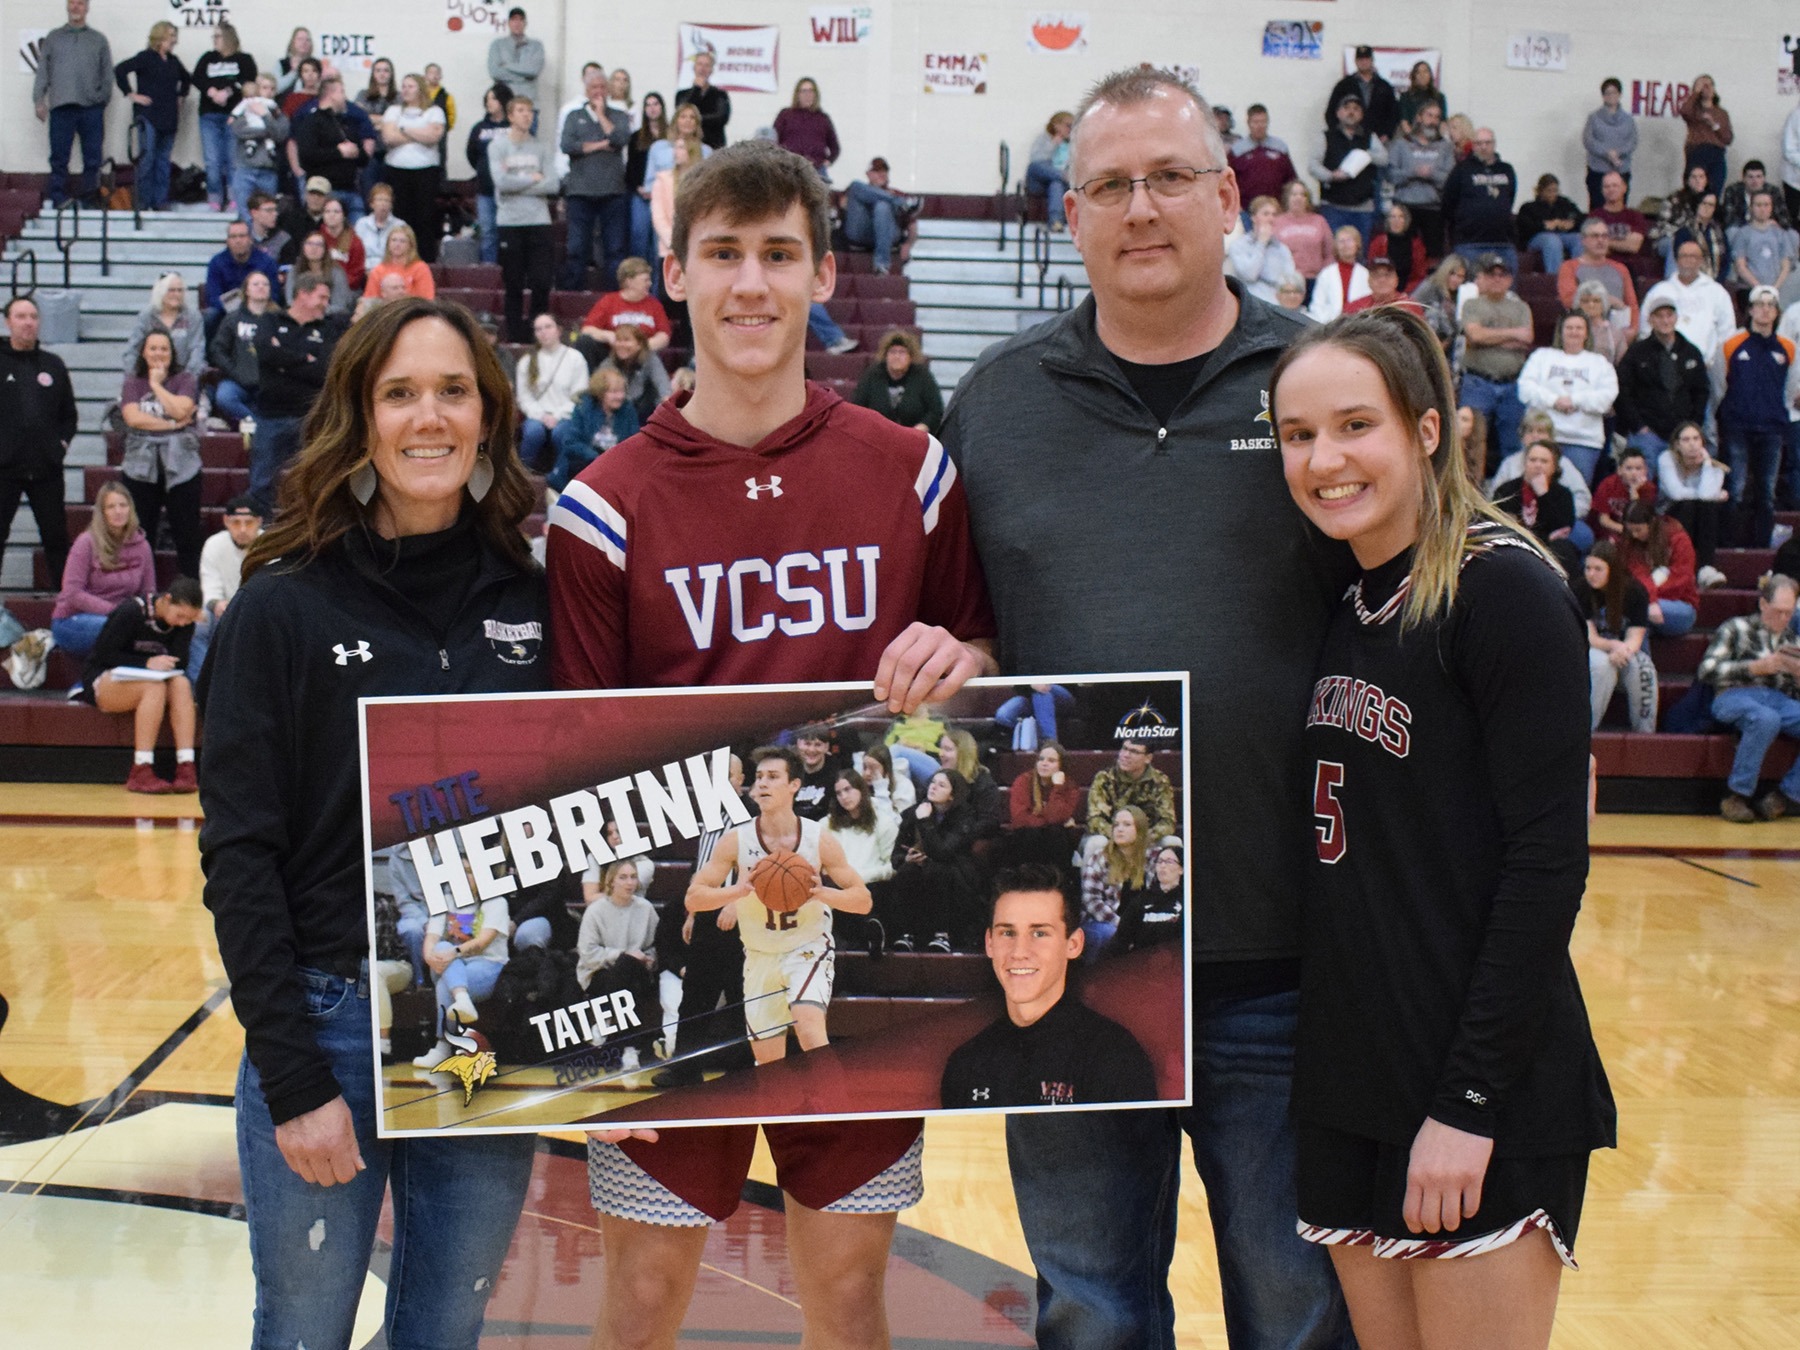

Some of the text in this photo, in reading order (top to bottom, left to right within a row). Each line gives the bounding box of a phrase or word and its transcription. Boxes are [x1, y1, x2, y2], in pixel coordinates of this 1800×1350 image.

[181, 8, 230, 26] TATE
[321, 35, 375, 56] EDDIE
[925, 54, 981, 72] EMMA
[664, 545, 880, 651] VCSU
[1113, 725, 1179, 739] NorthStar
[1306, 675, 1412, 758] KINGS
[389, 770, 490, 833] TATE
[408, 746, 752, 916] HEBRINK
[1313, 760, 1347, 865] 5
[529, 989, 642, 1053] TATER
[1465, 1089, 1487, 1106] DSG
